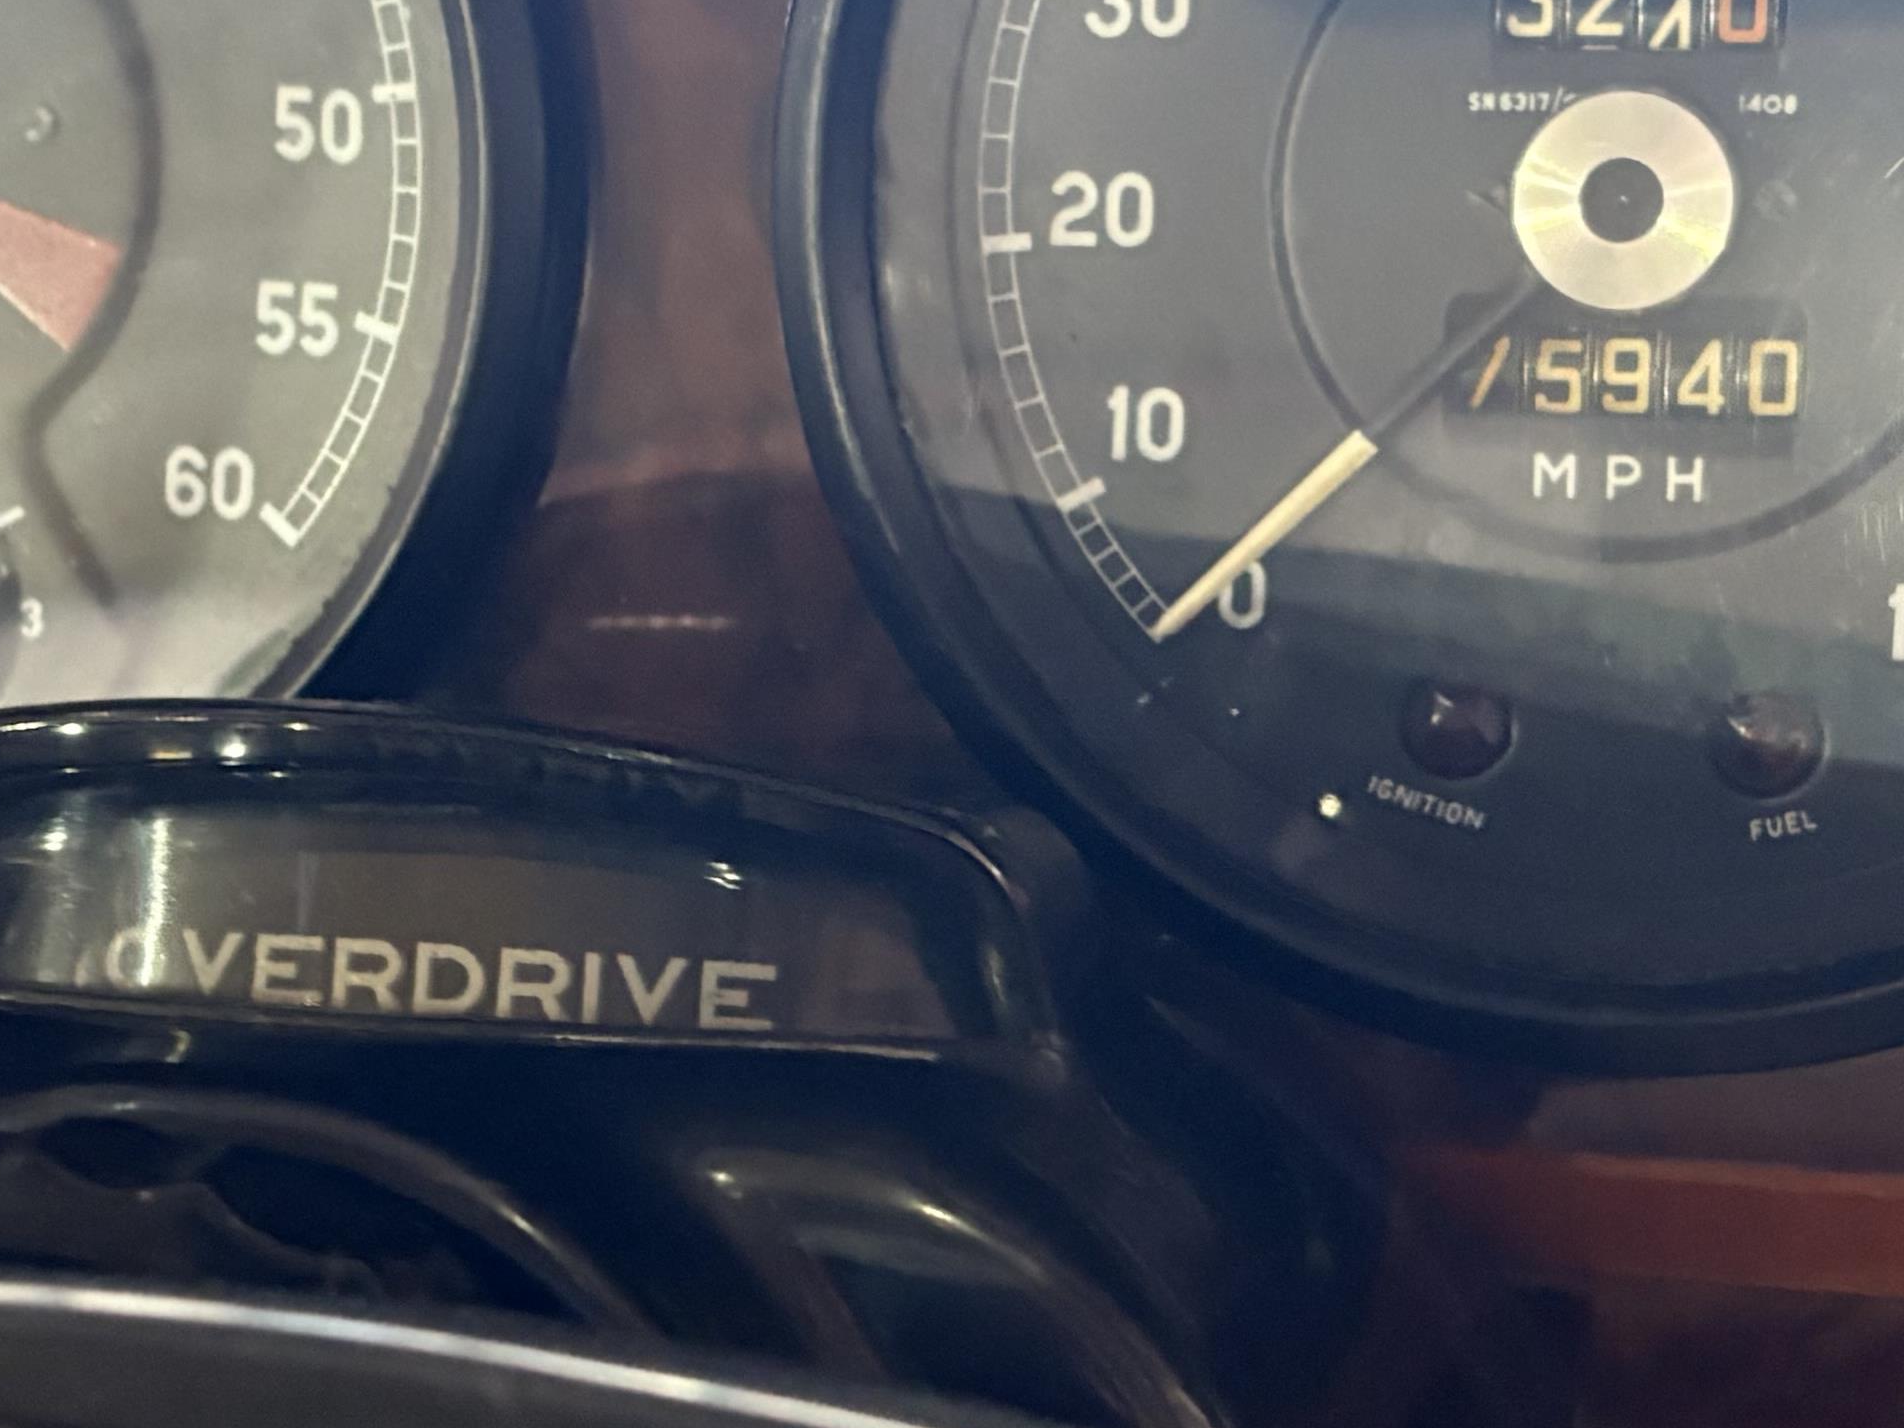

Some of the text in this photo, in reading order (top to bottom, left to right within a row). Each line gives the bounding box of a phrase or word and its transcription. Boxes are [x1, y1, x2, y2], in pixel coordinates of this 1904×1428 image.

[273, 84, 363, 164] 50
[1049, 170, 1155, 248] 20
[255, 278, 339, 357] 55
[1107, 385, 1186, 462] 10
[164, 444, 255, 520] 60
[21, 597, 44, 639] 3
[1367, 775, 1487, 832] IGNITION
[1749, 809, 1818, 842] FUEL
[104, 925, 778, 1031] OVERDRIVE
